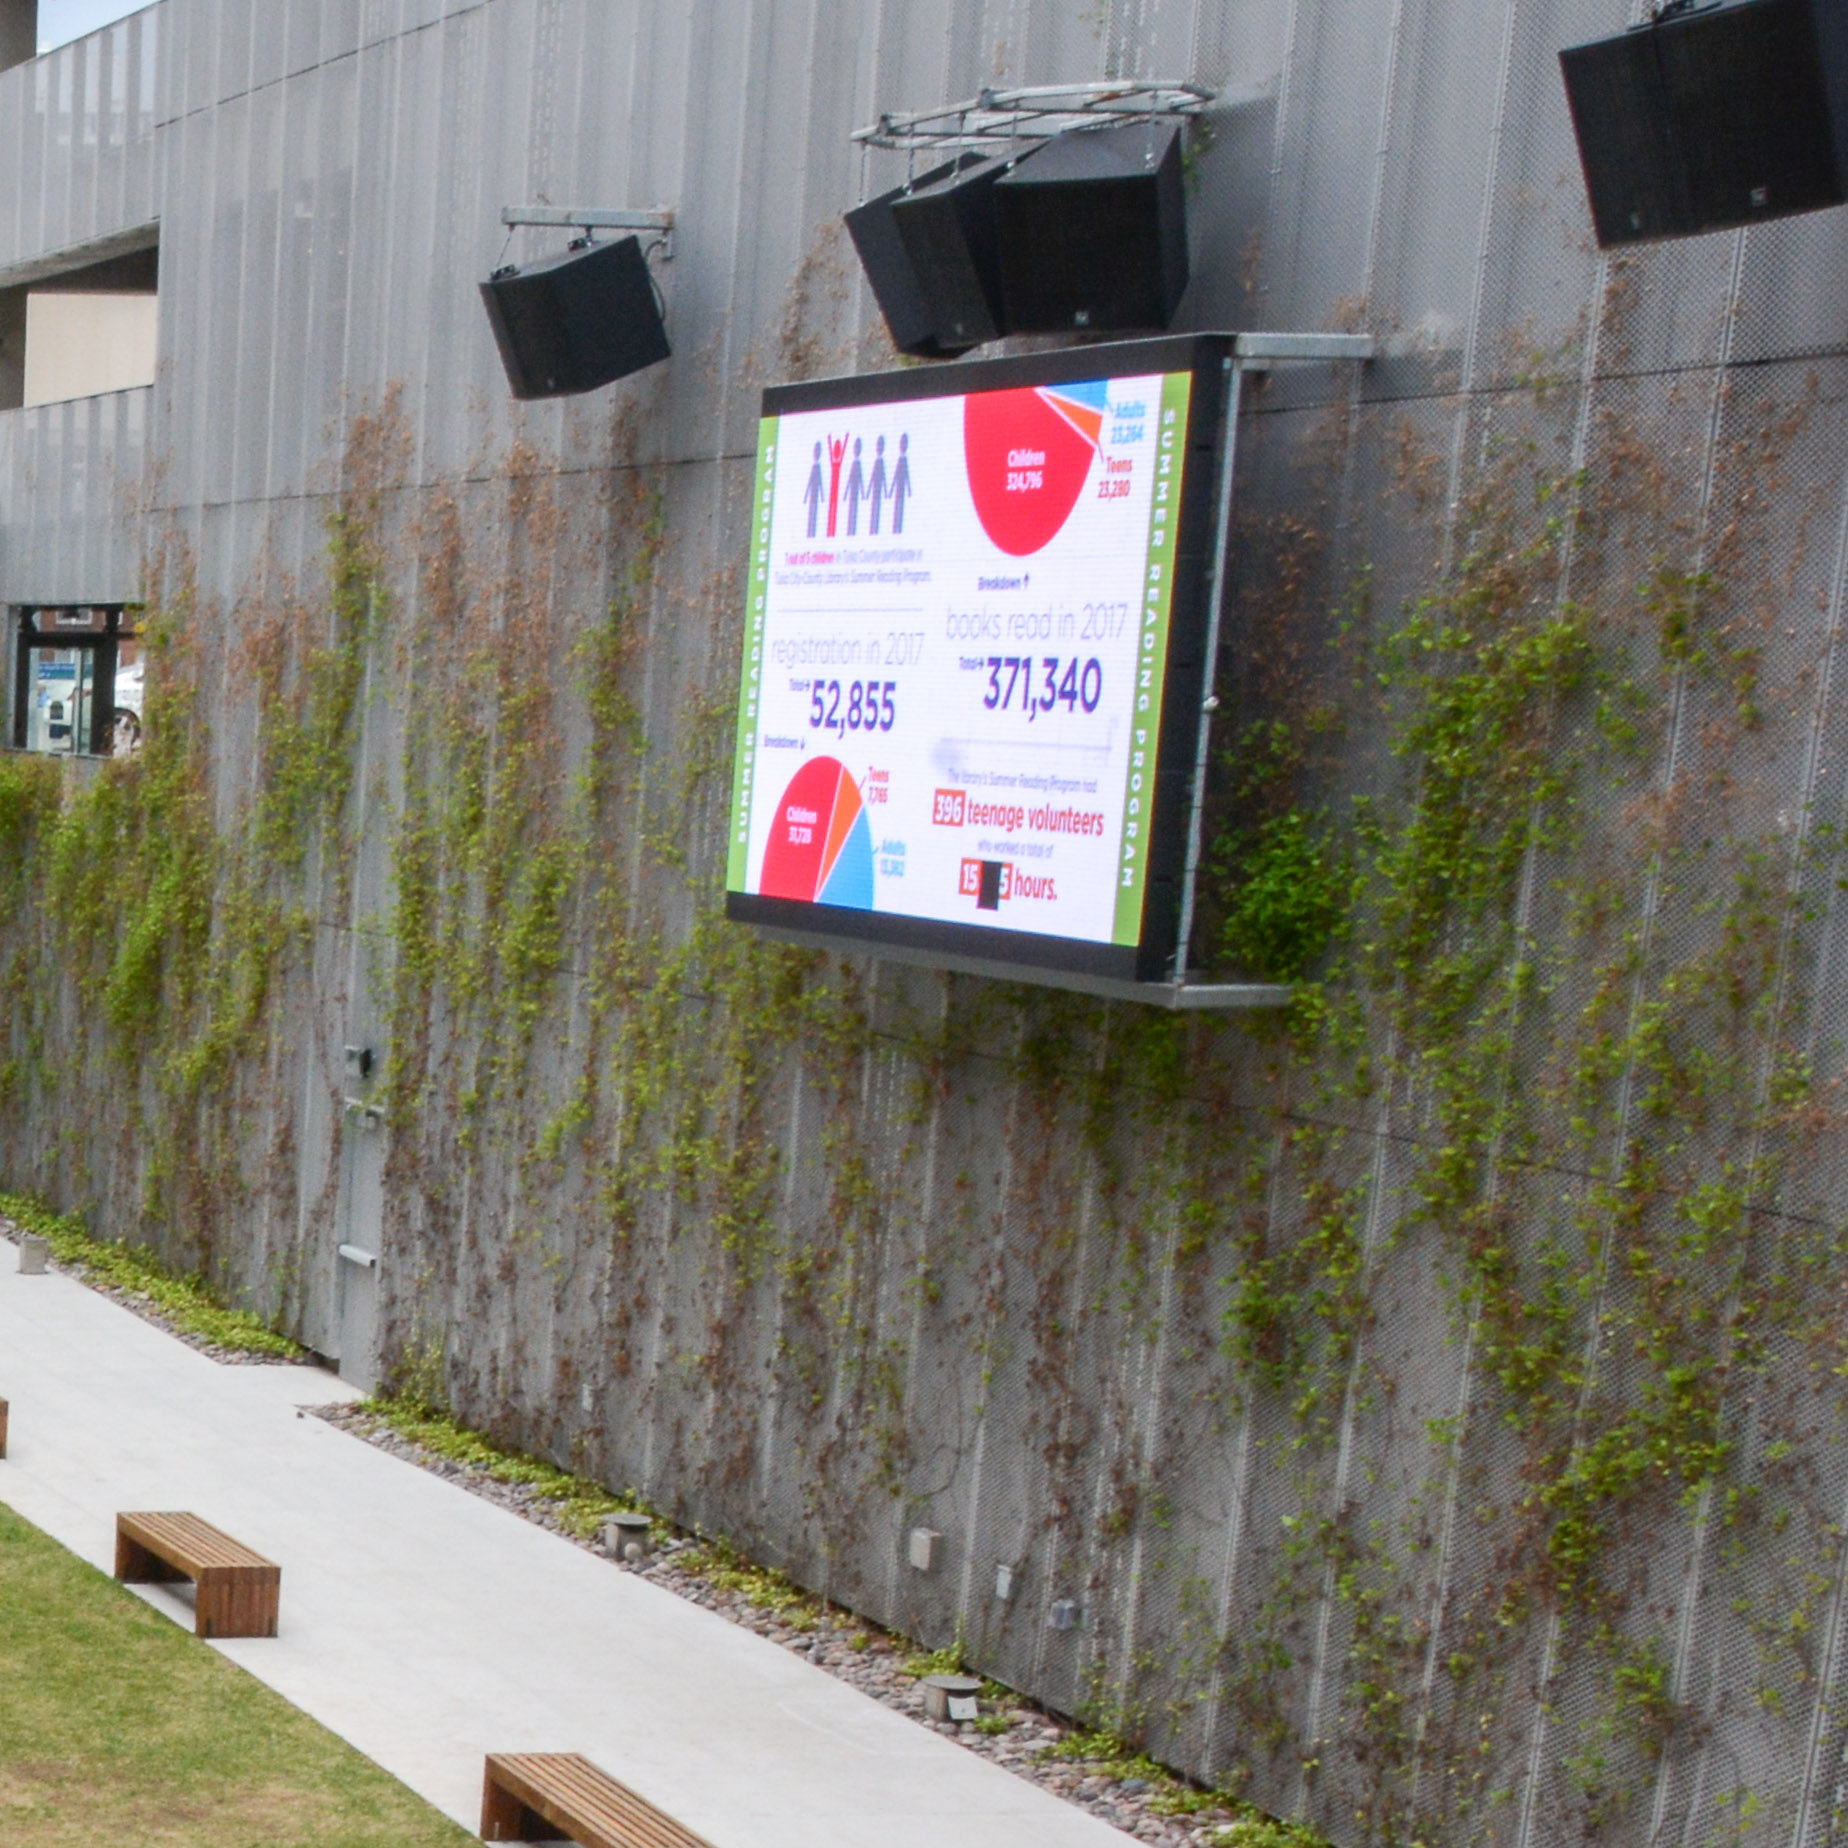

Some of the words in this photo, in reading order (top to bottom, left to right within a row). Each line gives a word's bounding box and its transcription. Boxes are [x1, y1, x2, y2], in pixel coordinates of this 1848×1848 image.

[1115, 401, 1146, 419] Adults
[1007, 448, 1046, 468] Children
[1106, 456, 1132, 474] Teens
[1006, 471, 1043, 492] 324,796
[1153, 409, 1176, 547] SUMMER
[1098, 480, 1131, 501] 23,280
[812, 552, 834, 565] children
[978, 576, 1021, 591] Breakdown
[946, 601, 1001, 640] books
[1006, 601, 1054, 640] read
[1057, 602, 1075, 639] in
[1080, 602, 1129, 640] 2017
[738, 732, 754, 842] SUMMER
[747, 596, 764, 718] READING
[756, 446, 775, 582] PROGRAM
[1138, 564, 1162, 712] READING
[771, 632, 862, 669] registration
[865, 632, 881, 664] in
[884, 631, 926, 665] 2017
[959, 656, 978, 670] Total
[983, 656, 1102, 723] 371,340
[789, 677, 806, 691] Total
[809, 679, 897, 740] 52,855
[764, 733, 799, 749] Breakdown
[868, 765, 889, 783] Teens
[989, 771, 1018, 788] Summer
[1018, 773, 1049, 793] Reading
[786, 805, 818, 825] Children
[935, 794, 963, 824] 396
[967, 798, 1024, 832] teenage
[1028, 803, 1105, 836] volunteers
[1121, 728, 1147, 887] PROGRAM
[1015, 867, 1057, 901] hours.
